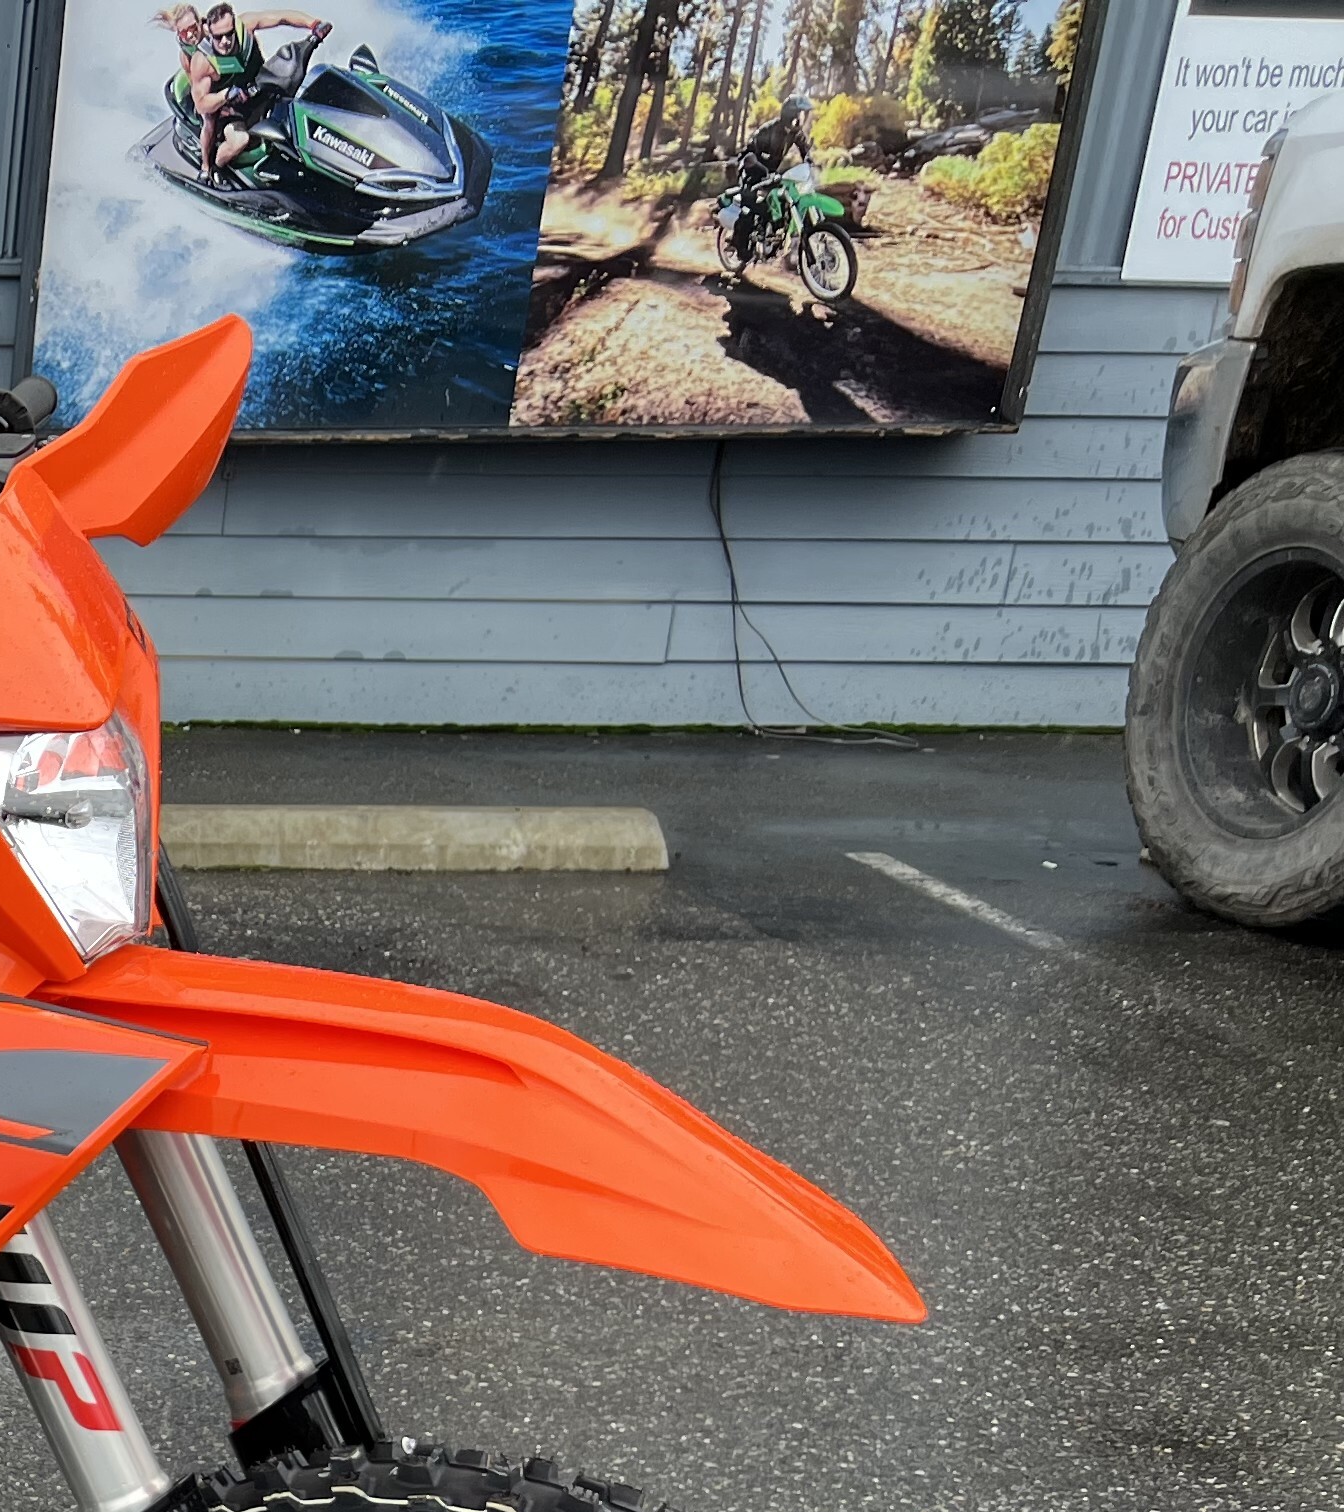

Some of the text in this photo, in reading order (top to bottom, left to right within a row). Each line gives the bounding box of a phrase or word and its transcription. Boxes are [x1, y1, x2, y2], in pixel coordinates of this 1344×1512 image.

[1175, 56, 1344, 88] It won't be much
[1188, 109, 1240, 140] your
[1243, 109, 1279, 133] car
[313, 125, 375, 167] Kawasaki
[1164, 161, 1261, 195] PRIVATE
[1157, 207, 1240, 240] for Cust
